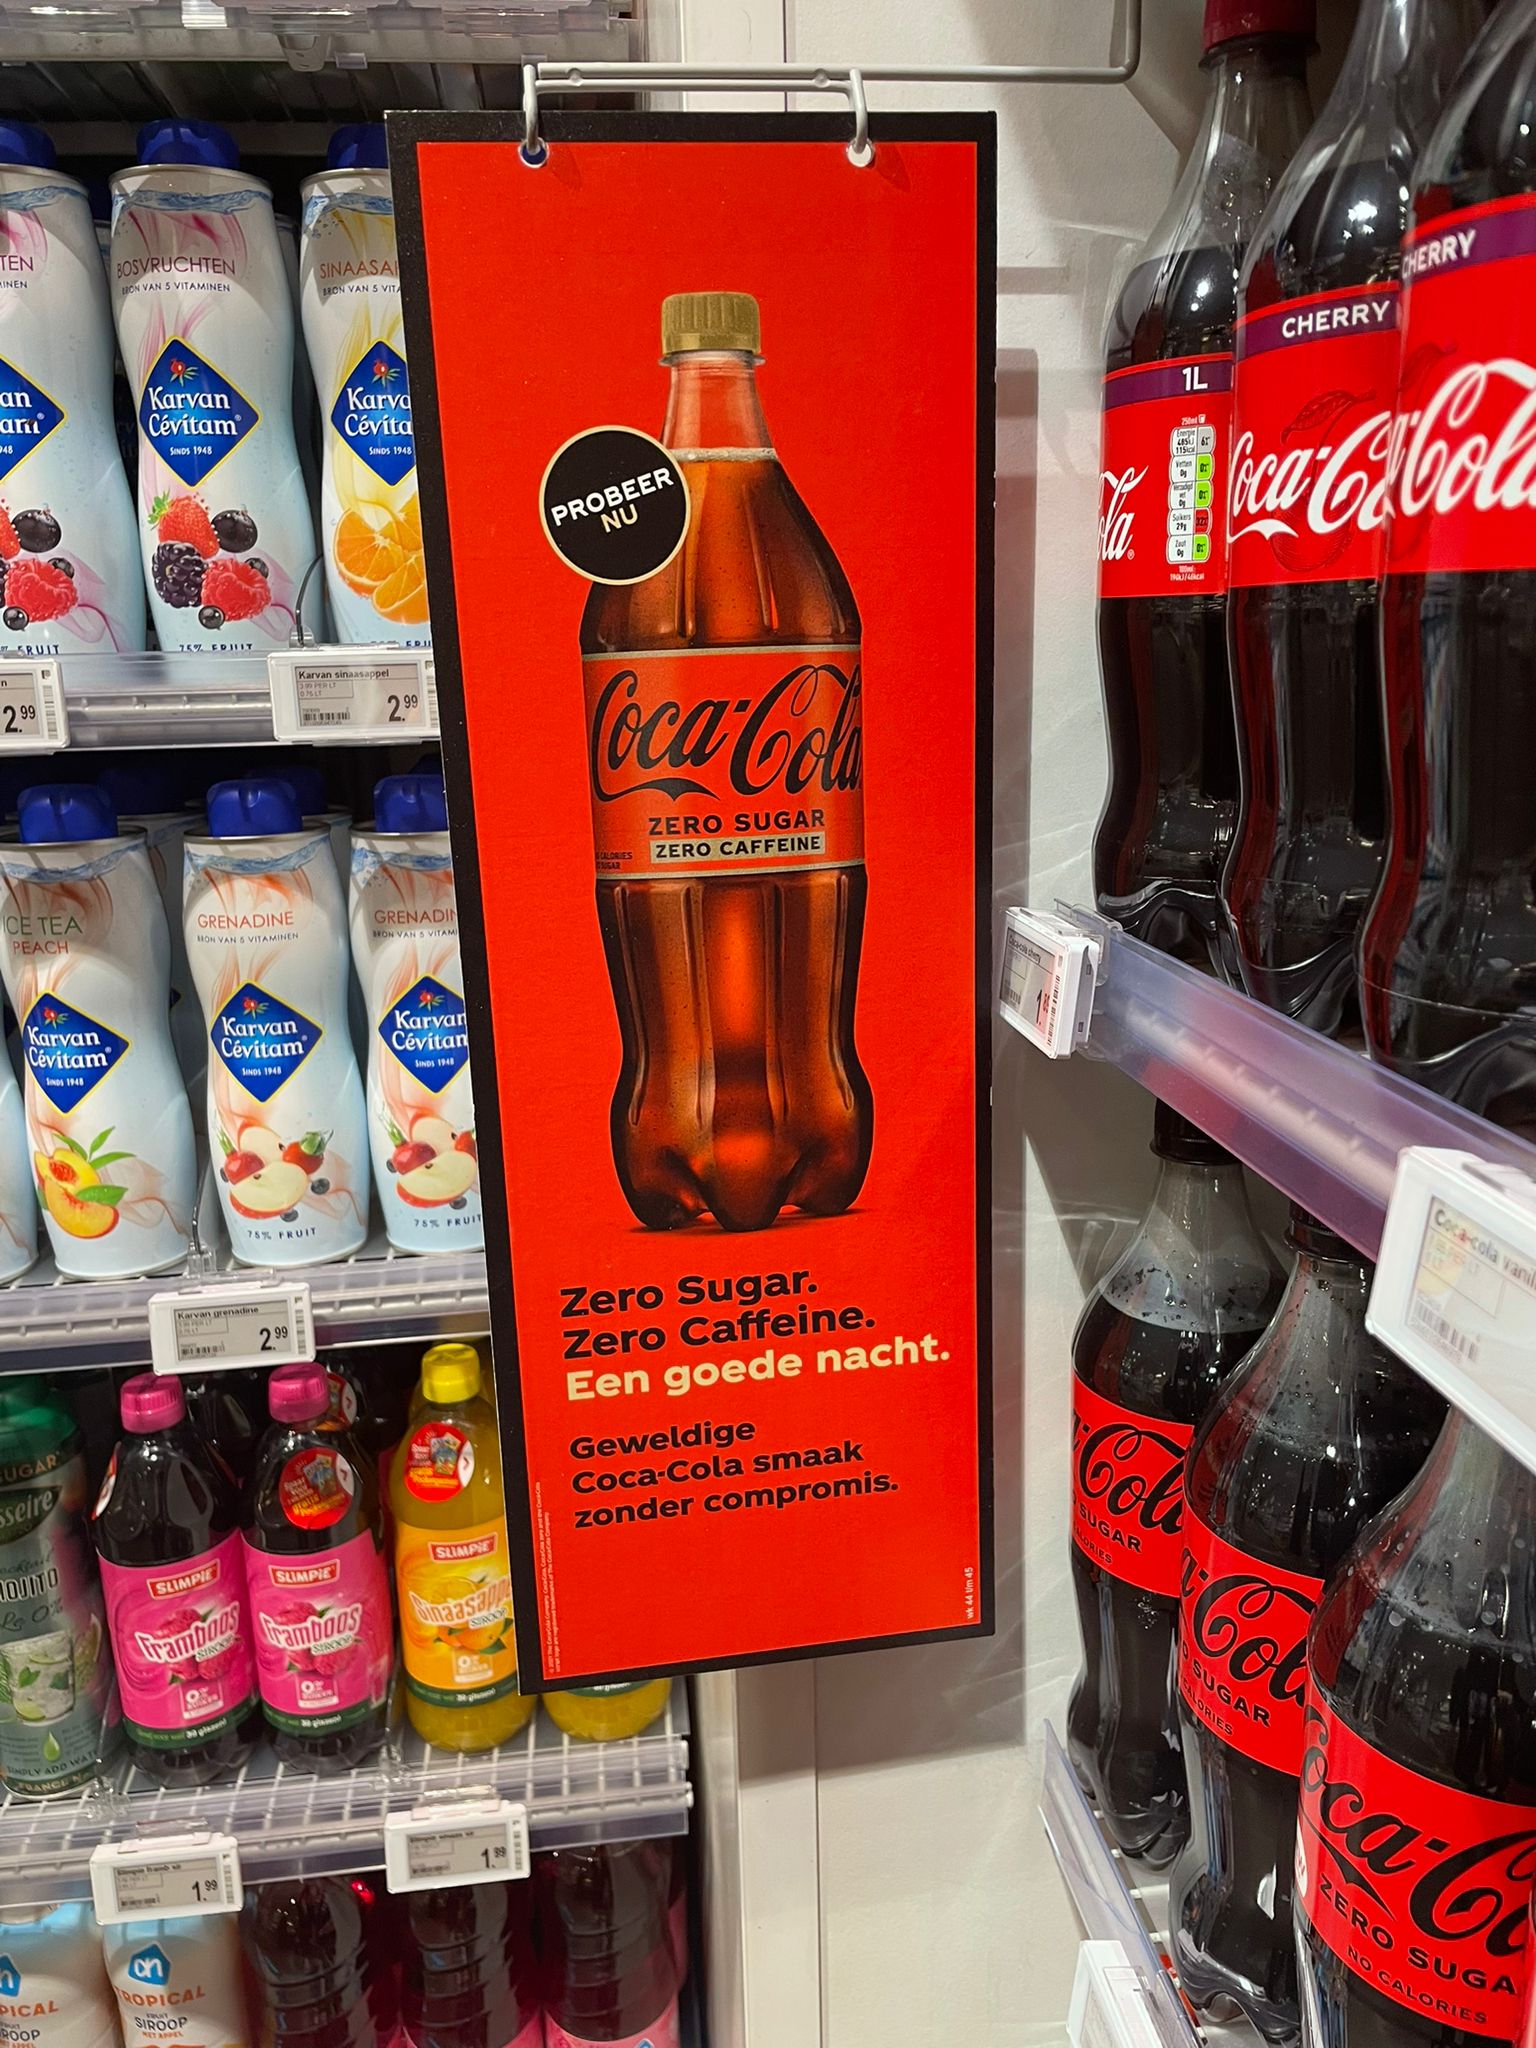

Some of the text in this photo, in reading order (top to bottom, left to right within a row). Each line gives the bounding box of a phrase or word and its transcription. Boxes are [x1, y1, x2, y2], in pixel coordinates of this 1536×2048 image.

[1402, 229, 1476, 280] CHERRY
[117, 256, 236, 279] BOSVRUCHTEN
[320, 260, 398, 279] SINAASA
[144, 283, 162, 292] VAN
[165, 282, 171, 290] 5
[175, 282, 230, 292] VITAMINEN
[348, 285, 369, 294] VAN
[373, 285, 379, 293] 5
[1282, 300, 1391, 339] CHERRY
[1182, 366, 1209, 391] 1L
[149, 387, 231, 411] Karvan
[347, 387, 410, 411] Karva
[149, 413, 238, 438] Cévitam
[344, 413, 413, 436] Cévita
[193, 446, 213, 456] 1948
[393, 446, 412, 455] 1948
[551, 467, 674, 526] PROBEER
[600, 504, 639, 533] NU
[299, 669, 390, 680] Karvan sinaasappel
[3, 705, 36, 733] 2.99
[387, 694, 418, 722] 2.99
[649, 809, 824, 835] ZERO SUGAR
[655, 836, 820, 858] ZERO CAFFEINE
[3, 916, 83, 935] ICE TEA
[198, 911, 294, 929] GRENADINE
[374, 909, 457, 924] GRENADI
[219, 935, 237, 943] VAN
[249, 932, 299, 943] VITAMINEN
[397, 930, 416, 938] VAN
[12, 941, 69, 955] PEACH
[27, 1025, 101, 1047] Karvan
[222, 1016, 298, 1038] Karvan
[29, 1046, 108, 1070] Cévitam
[221, 1037, 304, 1060] Cévitam
[264, 1066, 282, 1076] 1948
[437, 1058, 454, 1067] 1948
[67, 1077, 84, 1086] 1948
[447, 1213, 481, 1227] FRUIT
[278, 1227, 316, 1240] FRUIT
[560, 1270, 818, 1317] Zero Sugar.
[177, 1307, 259, 1320] Karvan grenadine
[259, 1326, 288, 1351] 2.99
[563, 1304, 875, 1359] Zero Caffeine.
[566, 1333, 950, 1401] Een goede nacht.
[570, 1420, 755, 1460] Geweldige
[572, 1440, 864, 1494] Coca-Cola smaak
[575, 1470, 899, 1529] zonder compromis.
[1079, 1502, 1142, 1553] SUGAR
[135, 1601, 240, 1662] Framboos
[259, 1603, 362, 1651] Framboos
[1192, 1658, 1271, 1728] SUGAR
[1319, 1871, 1394, 1951] ZERO
[1406, 1945, 1518, 1997] SUGA
[1346, 1943, 1488, 2026] NO CALORIES
[0, 2000, 59, 2018] PICAL
[0, 2028, 40, 2042] ROOP
[135, 2016, 188, 2032] SIROOP
